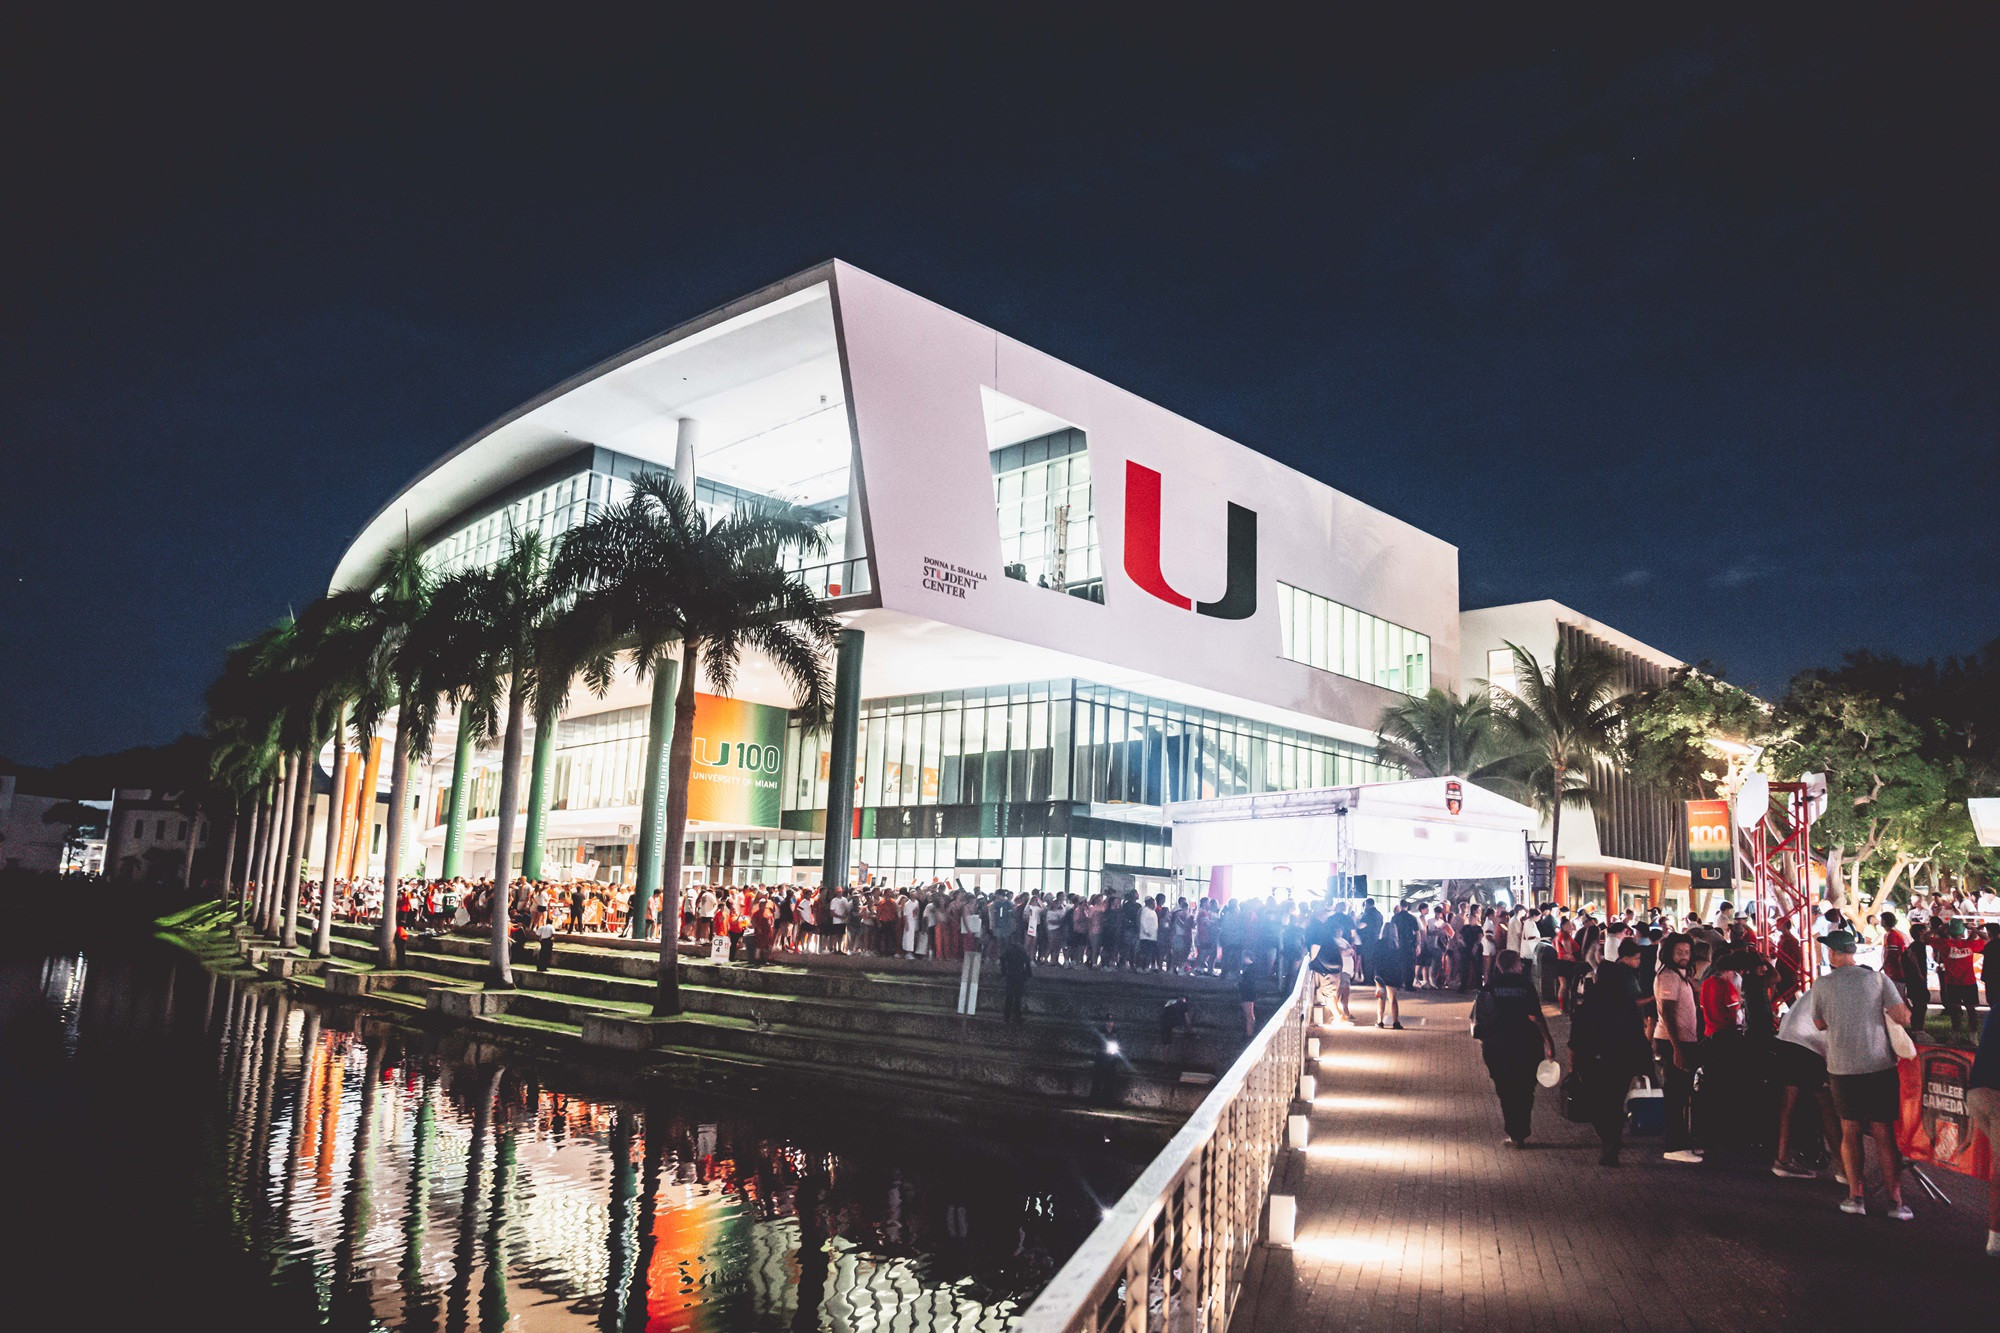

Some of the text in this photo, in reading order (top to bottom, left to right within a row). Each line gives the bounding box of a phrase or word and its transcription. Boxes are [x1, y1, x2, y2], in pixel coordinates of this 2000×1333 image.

[1124, 459, 1257, 620] U
[923, 566, 978, 590] STUDENT
[924, 557, 948, 569] DONNA
[958, 566, 987, 580] SHALALA
[922, 579, 966, 599] CENTER
[736, 742, 779, 774] 100
[693, 772, 741, 784] UNIVERSITY
[754, 780, 778, 789] MIAMI
[1690, 825, 1727, 846] 100
[1701, 868, 1720, 880] U
[446, 897, 456, 906] 12
[1928, 1082, 1964, 1100] COLLEGE
